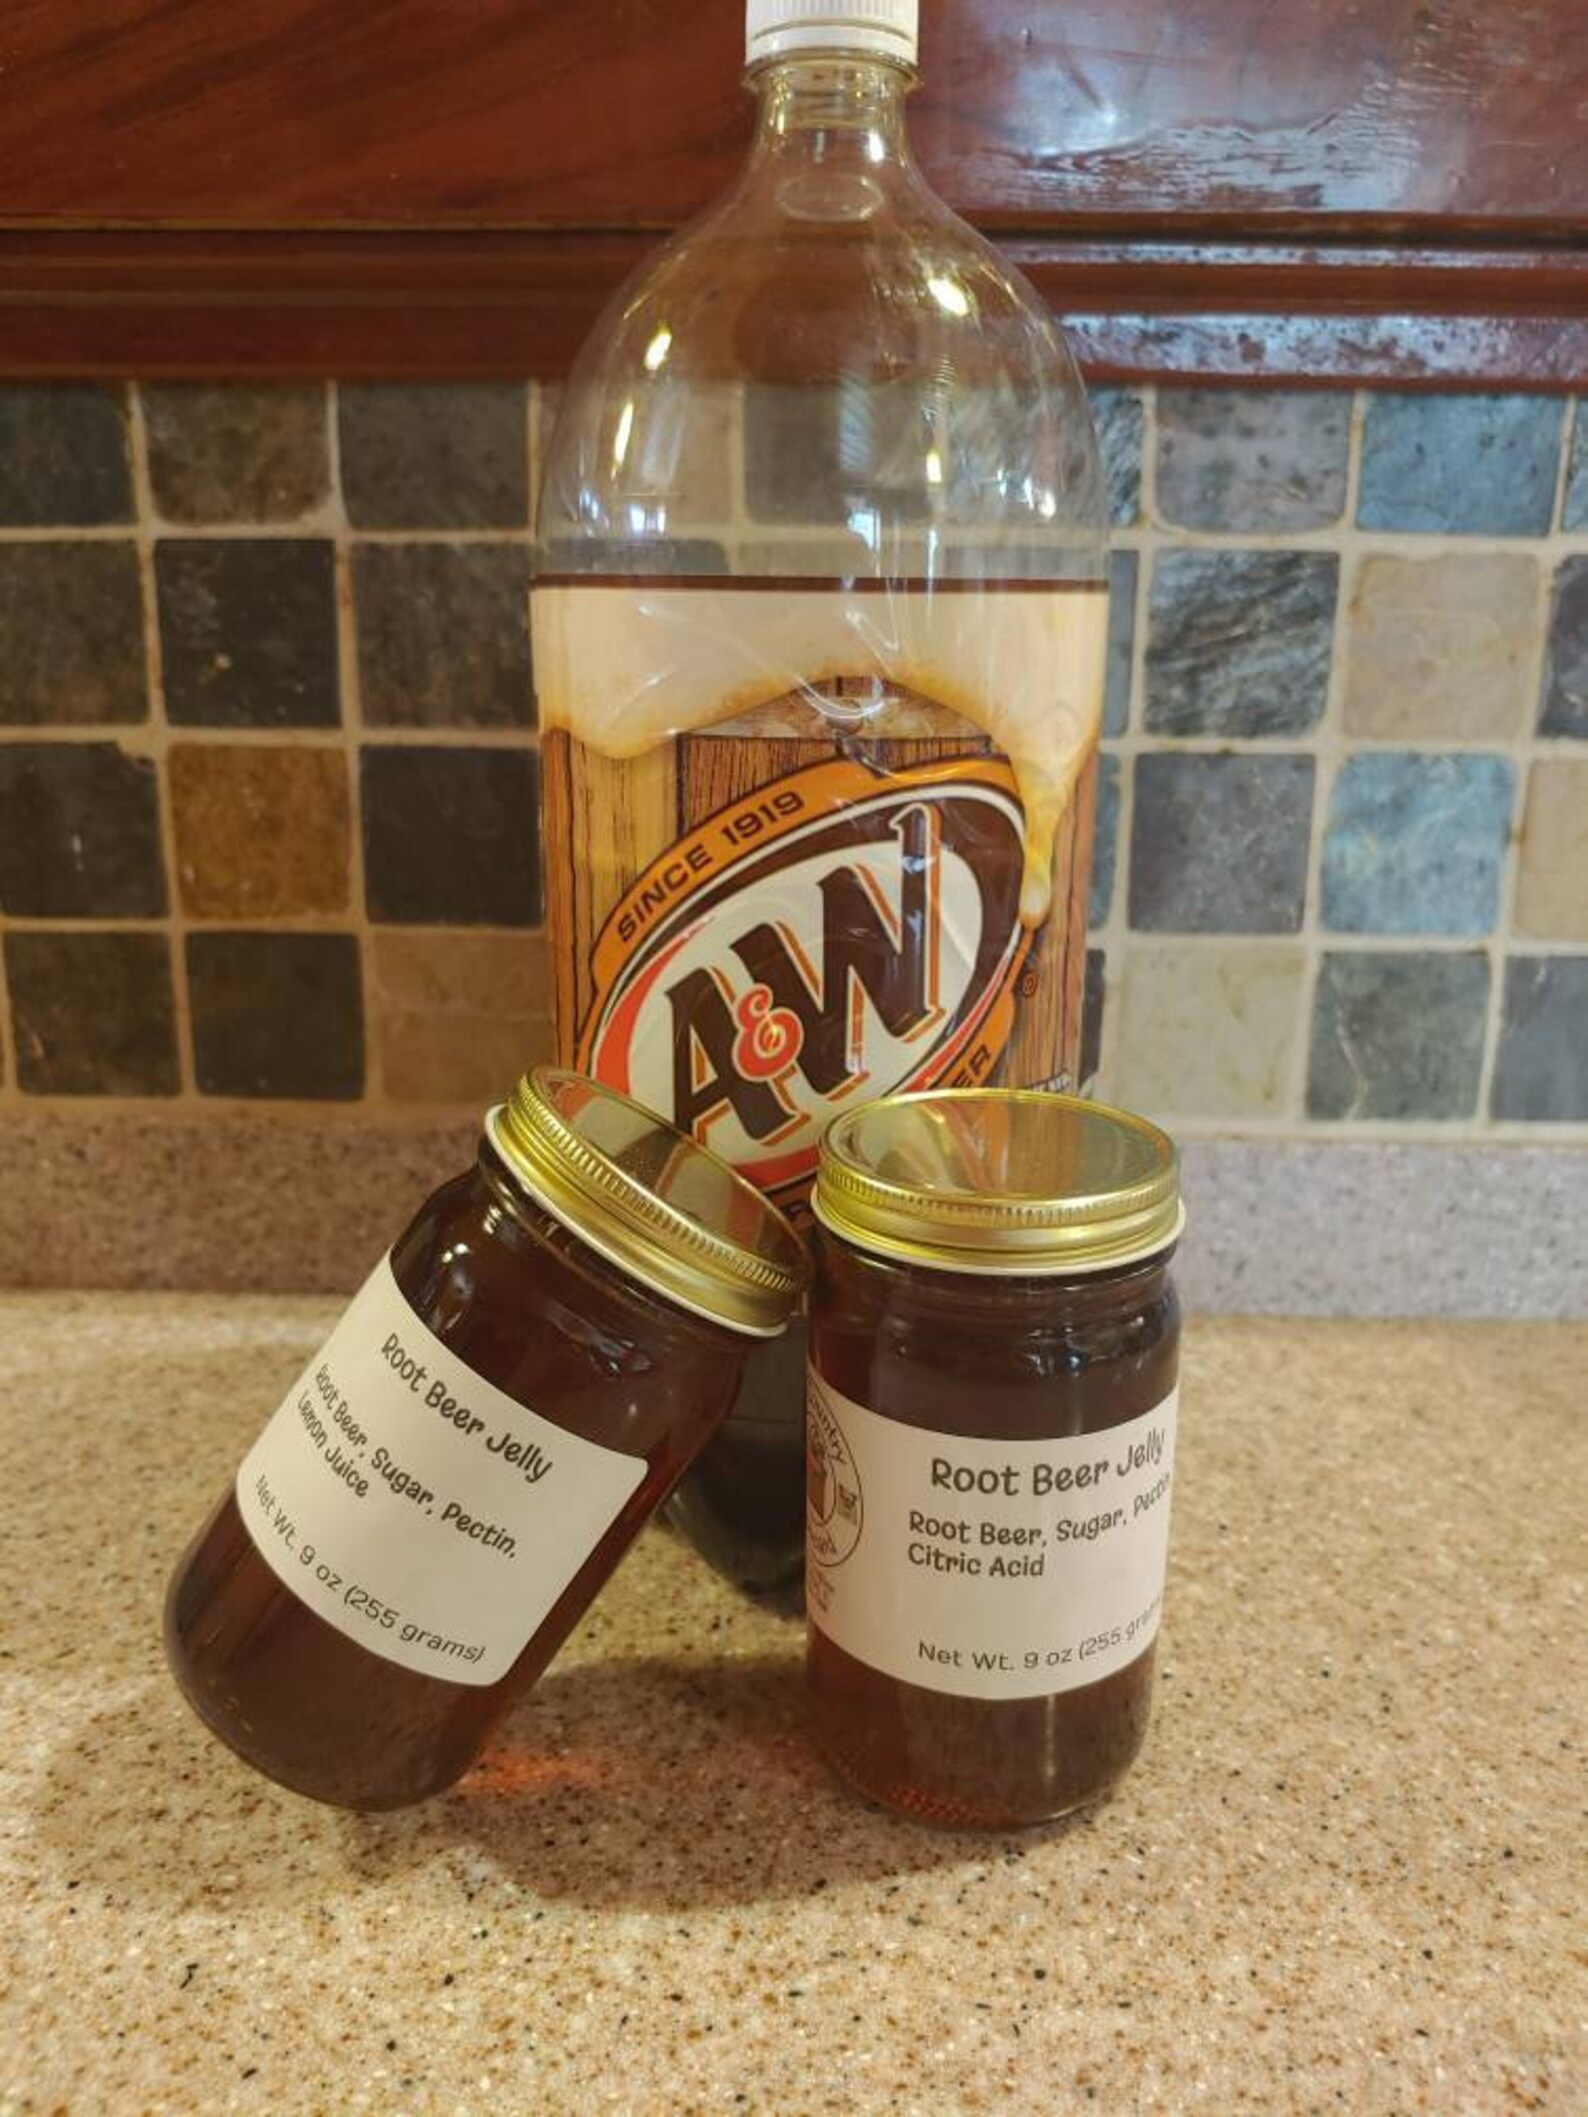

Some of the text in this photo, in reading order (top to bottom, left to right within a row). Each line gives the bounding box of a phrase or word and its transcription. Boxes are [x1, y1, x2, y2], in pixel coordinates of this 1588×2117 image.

[617, 790, 803, 943] SINCE 1919
[664, 802, 946, 1144] A&W
[297, 1388, 370, 1498] Lemon Juice
[315, 1362, 339, 1410] Root
[370, 1447, 435, 1515] Sugar,
[381, 1333, 554, 1484] Root Beer Jelly
[930, 1427, 1165, 1497] Root Beer Jelly
[255, 1473, 488, 1665] Net Wt. 9 oz (255 grams)
[907, 1509, 972, 1545] Root
[979, 1523, 1048, 1548] Beer,
[907, 1543, 1046, 1578] Citric Acid
[917, 1640, 963, 1668] Net
[971, 1649, 1015, 1671] Wt.
[1023, 1652, 1041, 1670] 9
[1047, 1650, 1073, 1667] oz
[1078, 1626, 1122, 1660] (255
